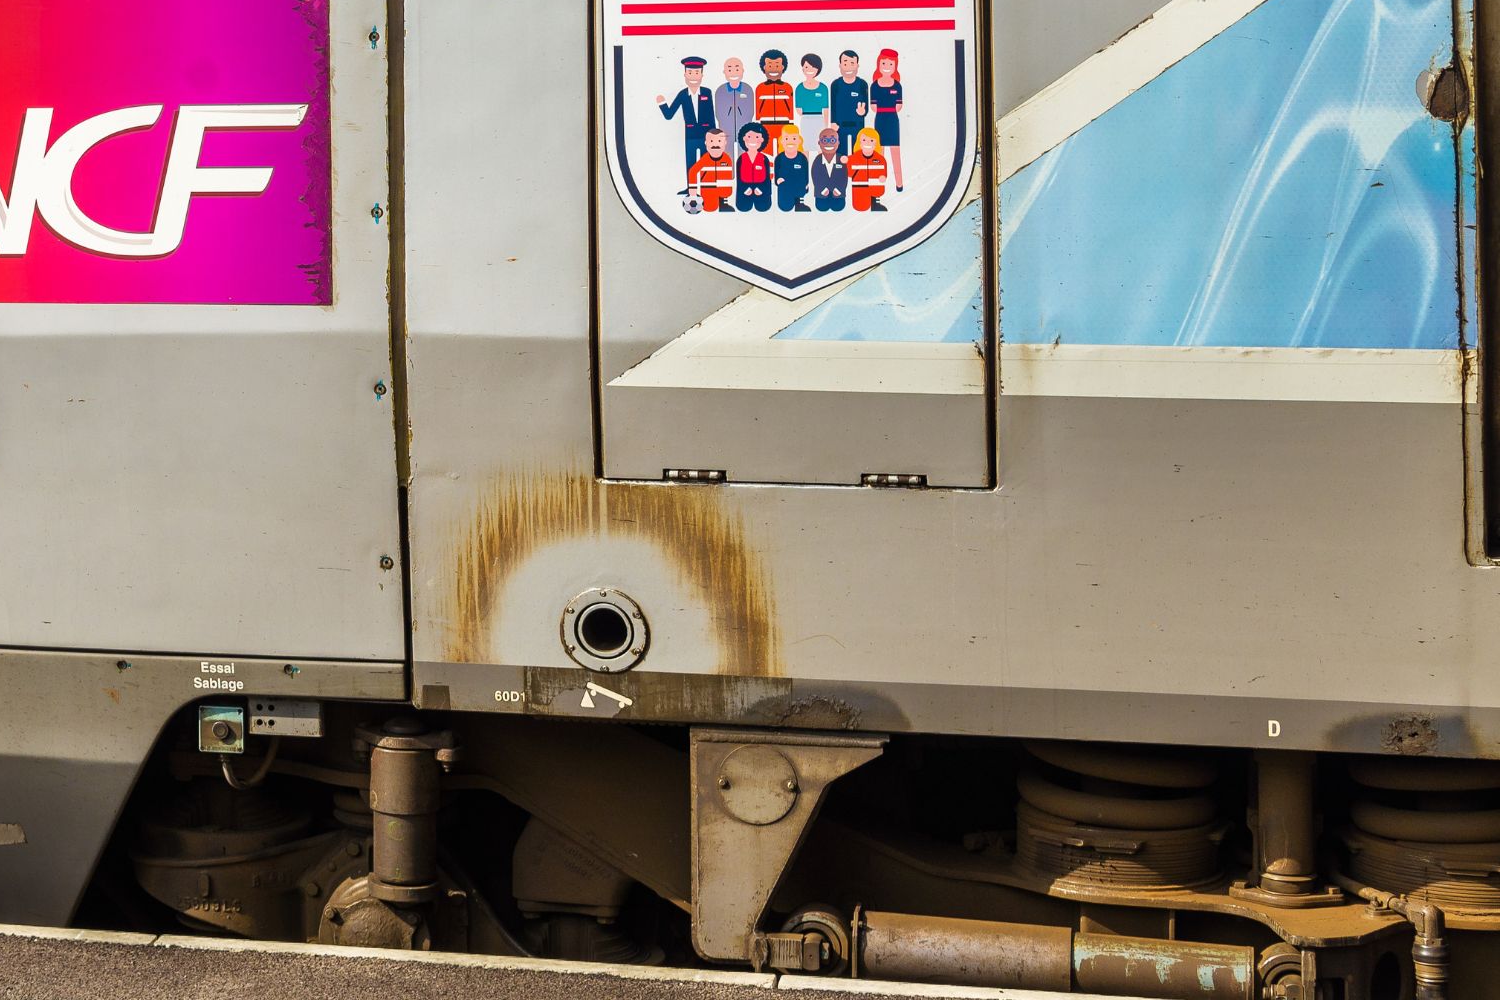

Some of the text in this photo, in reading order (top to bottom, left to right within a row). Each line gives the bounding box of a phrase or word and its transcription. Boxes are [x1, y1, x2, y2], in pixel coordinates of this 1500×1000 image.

[200, 661, 235, 674] Essai
[193, 677, 244, 692] Sablage
[1267, 719, 1281, 737] D
